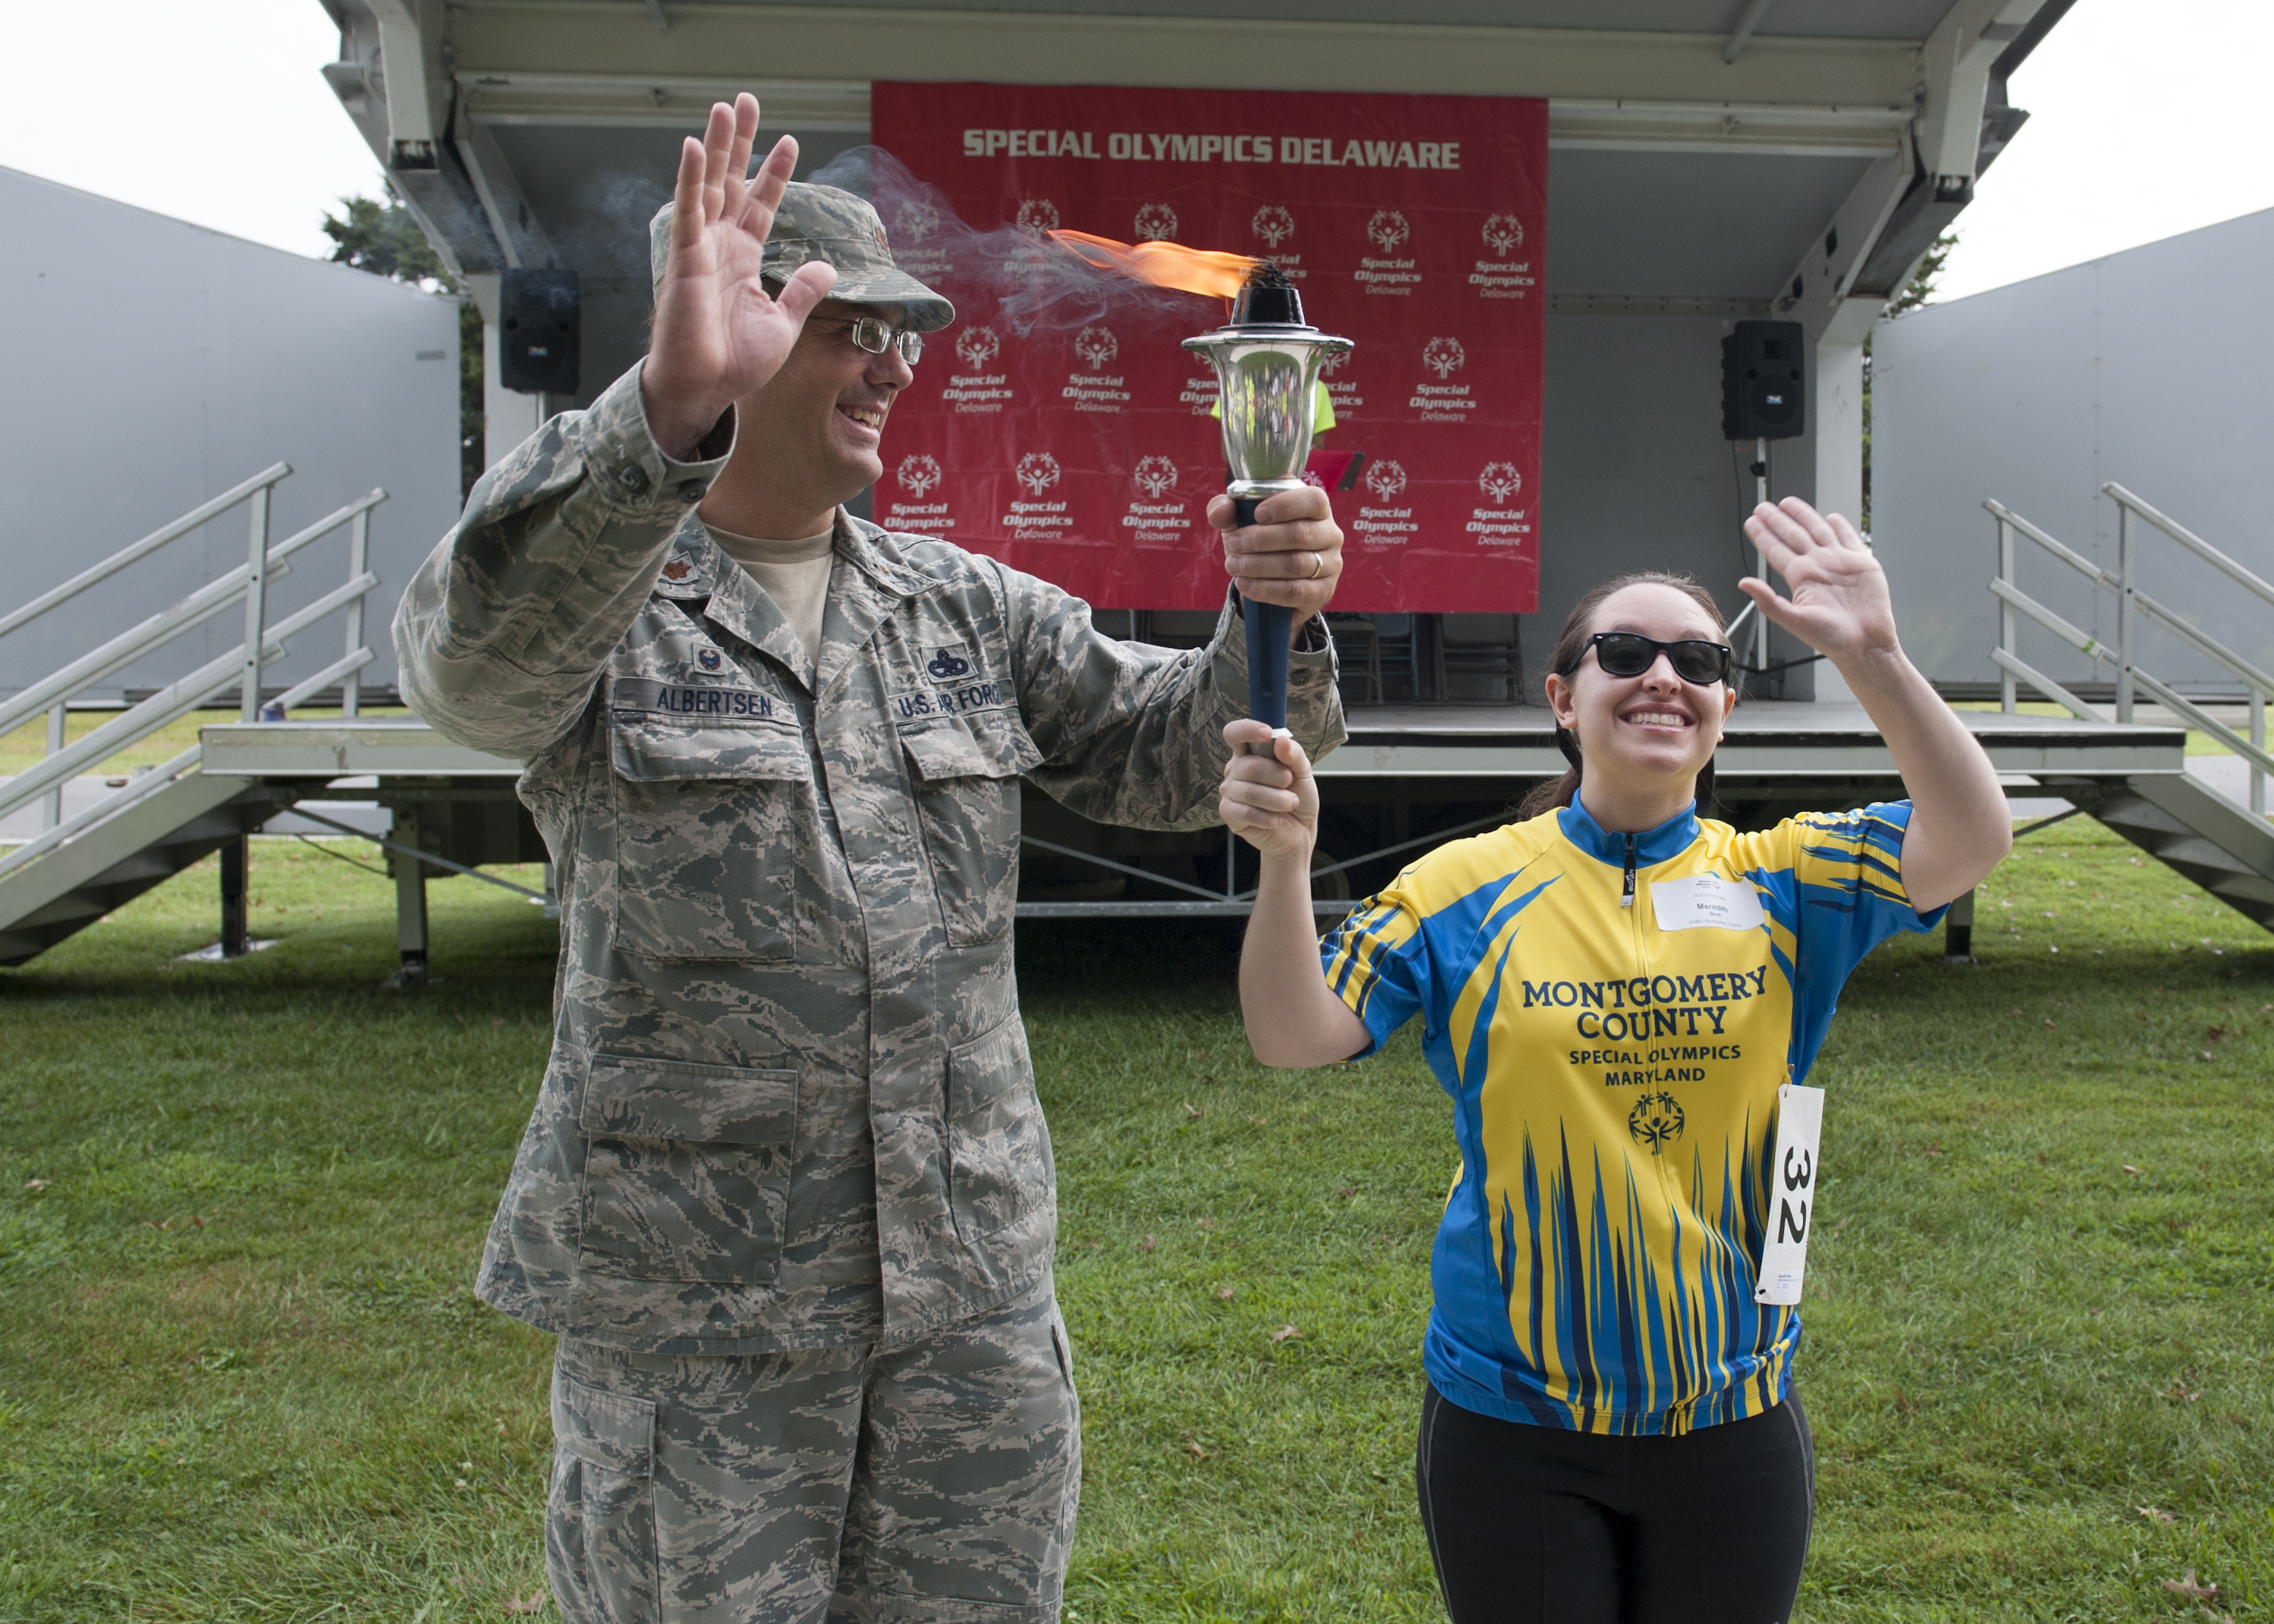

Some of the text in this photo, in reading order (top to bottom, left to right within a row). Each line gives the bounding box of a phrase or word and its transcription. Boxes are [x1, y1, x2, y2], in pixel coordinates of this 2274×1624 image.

[963, 129, 1460, 169] SPECIAL OLYMPICS DELAWARE
[1360, 257, 1415, 271] Special
[1475, 260, 1529, 274] Special
[1354, 269, 1421, 284] Olympics
[1468, 273, 1535, 287] Olympics
[1365, 284, 1412, 296] Delaware
[1480, 287, 1525, 299] Delaware
[950, 374, 1006, 388] Special
[1069, 373, 1124, 388] Special
[943, 388, 1013, 401] Olympics
[1062, 387, 1131, 401] Olympics
[1415, 384, 1470, 397] Special
[955, 402, 1002, 413] Delaware
[1074, 401, 1120, 413] Delaware
[1409, 397, 1476, 410] Olympics
[1420, 410, 1467, 422] Delaware
[891, 503, 948, 516] Special
[1010, 501, 1066, 515] Special
[1129, 502, 1184, 516] Special
[1359, 507, 1412, 520] Special
[1472, 509, 1524, 521] Special
[884, 517, 955, 529] Olympics
[1003, 514, 1074, 529] Olympics
[1122, 516, 1191, 530] Olympics
[1353, 520, 1418, 533] Olympics
[1466, 521, 1531, 535] Olympics
[1014, 528, 1063, 540] Delaware
[1134, 529, 1181, 542] Delaware
[1364, 533, 1408, 545] Delaware
[1478, 534, 1522, 546] Delaware
[657, 686, 772, 716] ALBERTSEN
[898, 693, 936, 717] U.S.
[1697, 903, 1729, 913] Meredith
[1522, 965, 1767, 1009] MONTGOMERY
[1577, 1006, 1727, 1041] COUNTY
[1569, 1044, 1742, 1065] SPECIAL OLYMPICS
[1605, 1067, 1706, 1086] MARYLAND
[1777, 1145, 1811, 1244] 32
